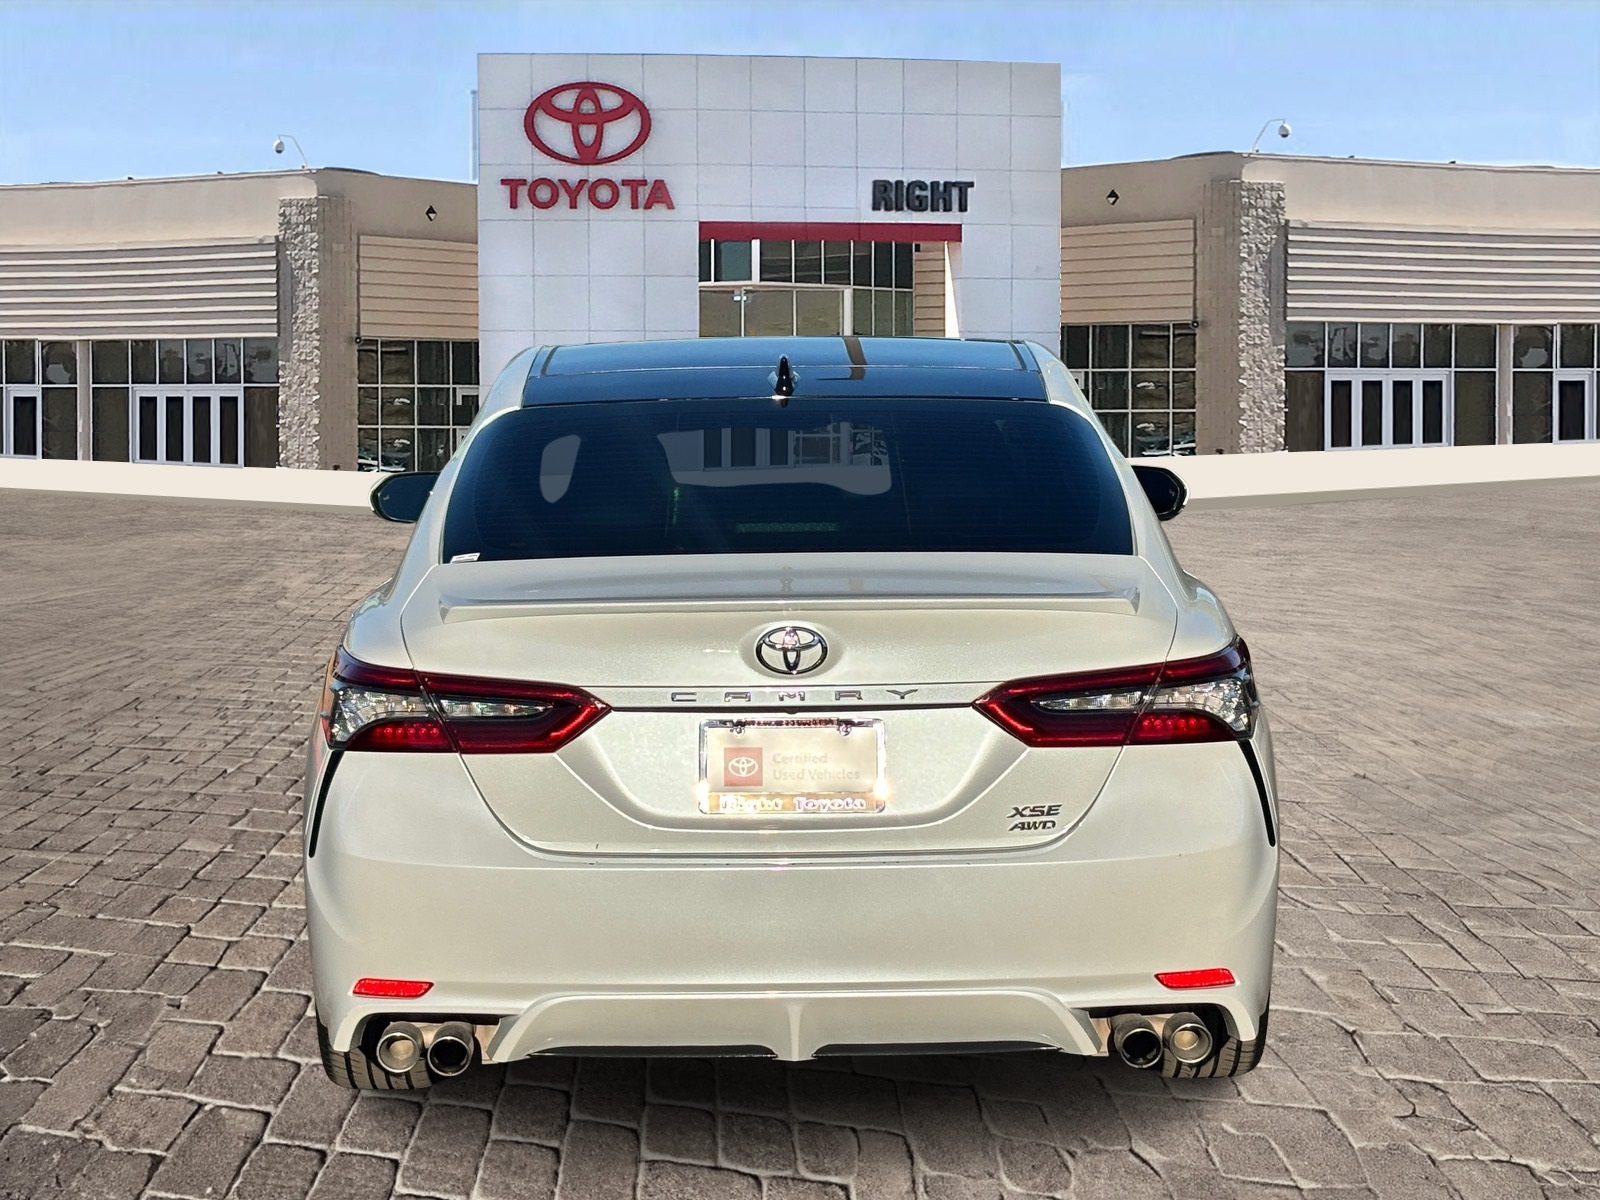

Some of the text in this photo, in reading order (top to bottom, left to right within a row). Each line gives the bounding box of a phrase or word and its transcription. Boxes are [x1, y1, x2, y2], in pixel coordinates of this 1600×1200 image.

[500, 177, 675, 210] TOYOTA
[872, 179, 975, 212] RIGHT
[671, 688, 918, 702] CAMRY
[772, 753, 828, 764] Certified
[772, 768, 861, 780] Used Vehicles
[793, 796, 867, 813] Toyota
[1006, 804, 1063, 818] XSE
[1008, 820, 1056, 831] AWD
